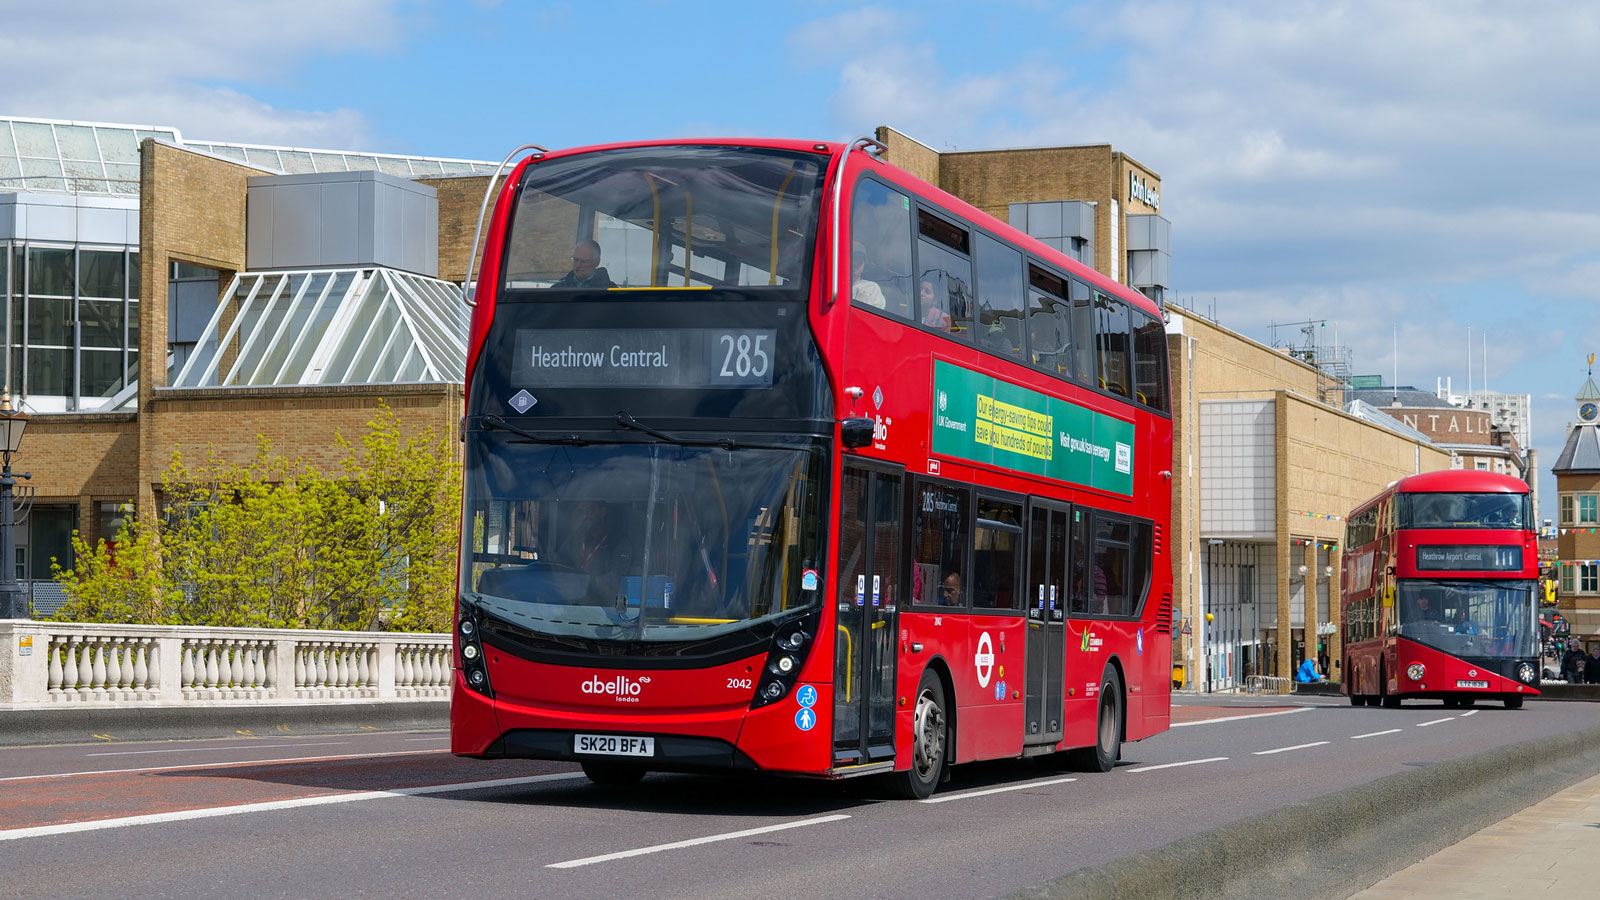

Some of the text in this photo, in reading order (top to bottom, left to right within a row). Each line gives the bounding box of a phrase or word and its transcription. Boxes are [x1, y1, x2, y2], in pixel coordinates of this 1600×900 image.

[1129, 170, 1159, 210] John Lewis
[531, 345, 669, 367] Heathrow Central
[719, 334, 769, 377] 285
[938, 415, 967, 433] UK Government
[977, 396, 988, 415] Our
[1027, 412, 1037, 432] tips
[1037, 417, 1052, 434] coud
[1389, 413, 1491, 435] NTALLS
[976, 425, 988, 441] save
[988, 428, 1000, 446] you
[1000, 429, 1026, 451] hundreds
[1026, 437, 1033, 453] of
[1059, 431, 1071, 449] Visit
[922, 491, 935, 513] 285
[1422, 551, 1482, 563] Heathrow Airport Central
[1494, 551, 1513, 566] 111
[581, 674, 641, 696] abellio
[726, 678, 752, 689] 2042
[580, 737, 647, 754] SK20 BFA
